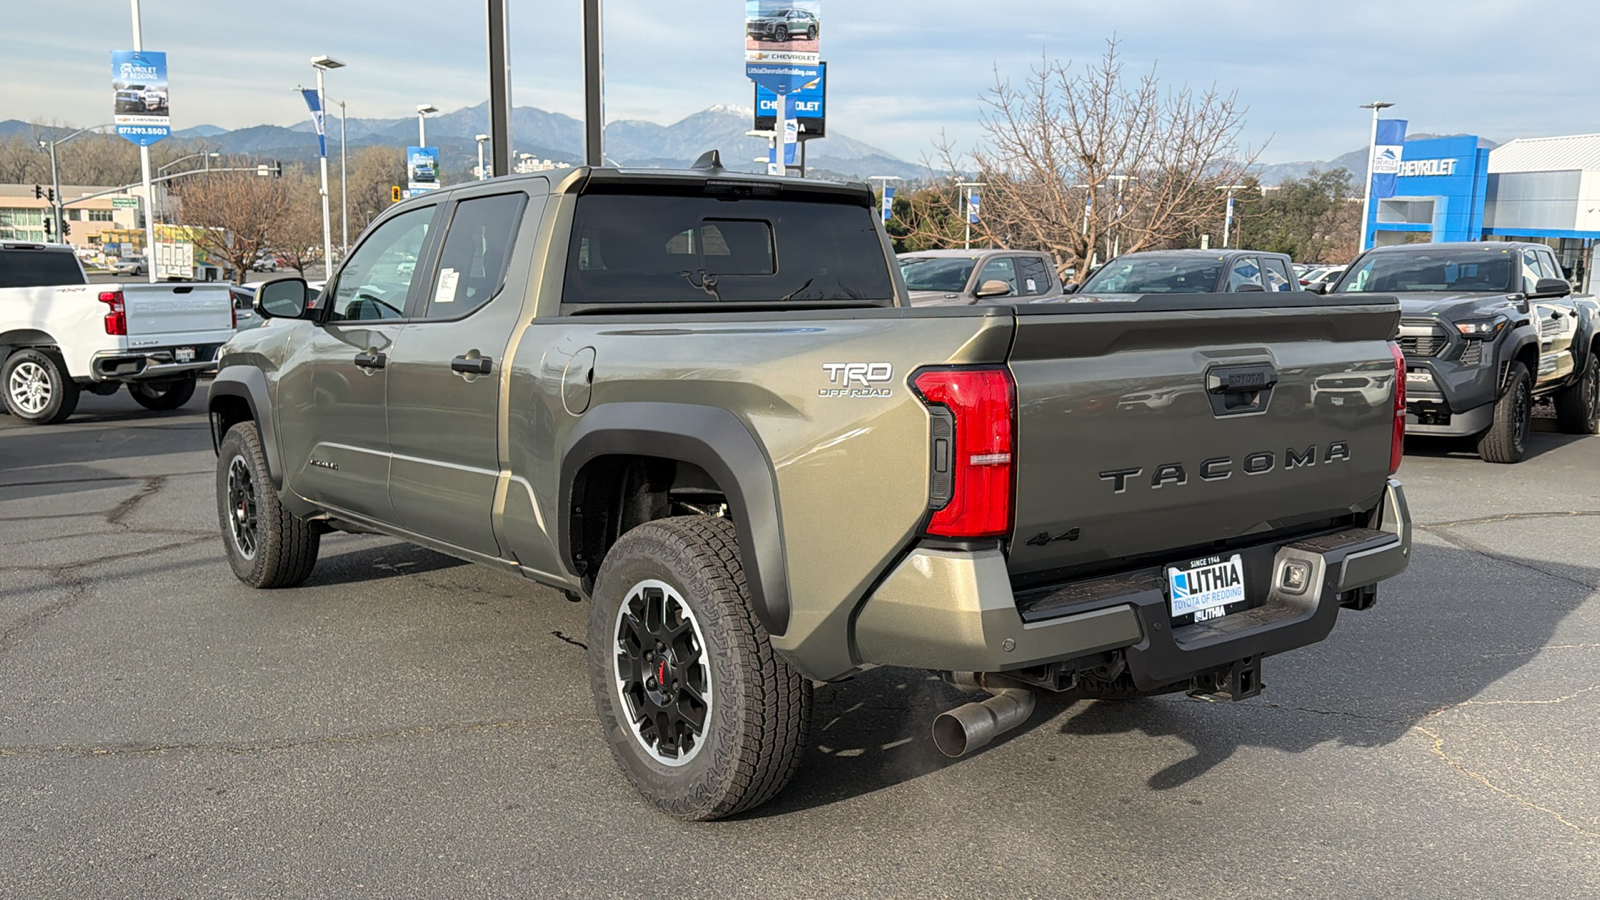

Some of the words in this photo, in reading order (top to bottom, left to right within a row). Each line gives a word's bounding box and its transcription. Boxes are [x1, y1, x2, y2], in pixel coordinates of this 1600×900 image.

[748, 68, 816, 76] LithiaChevroletRedding.com
[760, 100, 820, 111] CHEOLET
[118, 126, 167, 135] 877.293.5503
[822, 362, 893, 388] TRD
[1230, 373, 1261, 385] TOYOTA
[818, 388, 848, 398] OFF
[850, 388, 893, 398] ROAD
[1098, 440, 1351, 494] TACOMA
[1190, 559, 1207, 568] SINCE
[1207, 555, 1220, 565] 1946
[1187, 563, 1241, 595] LITHIA
[1173, 596, 1200, 610] TOYOTA
[1202, 593, 1211, 604] OF
[1211, 587, 1242, 602] REDDING
[1202, 605, 1226, 621] LITHIA
